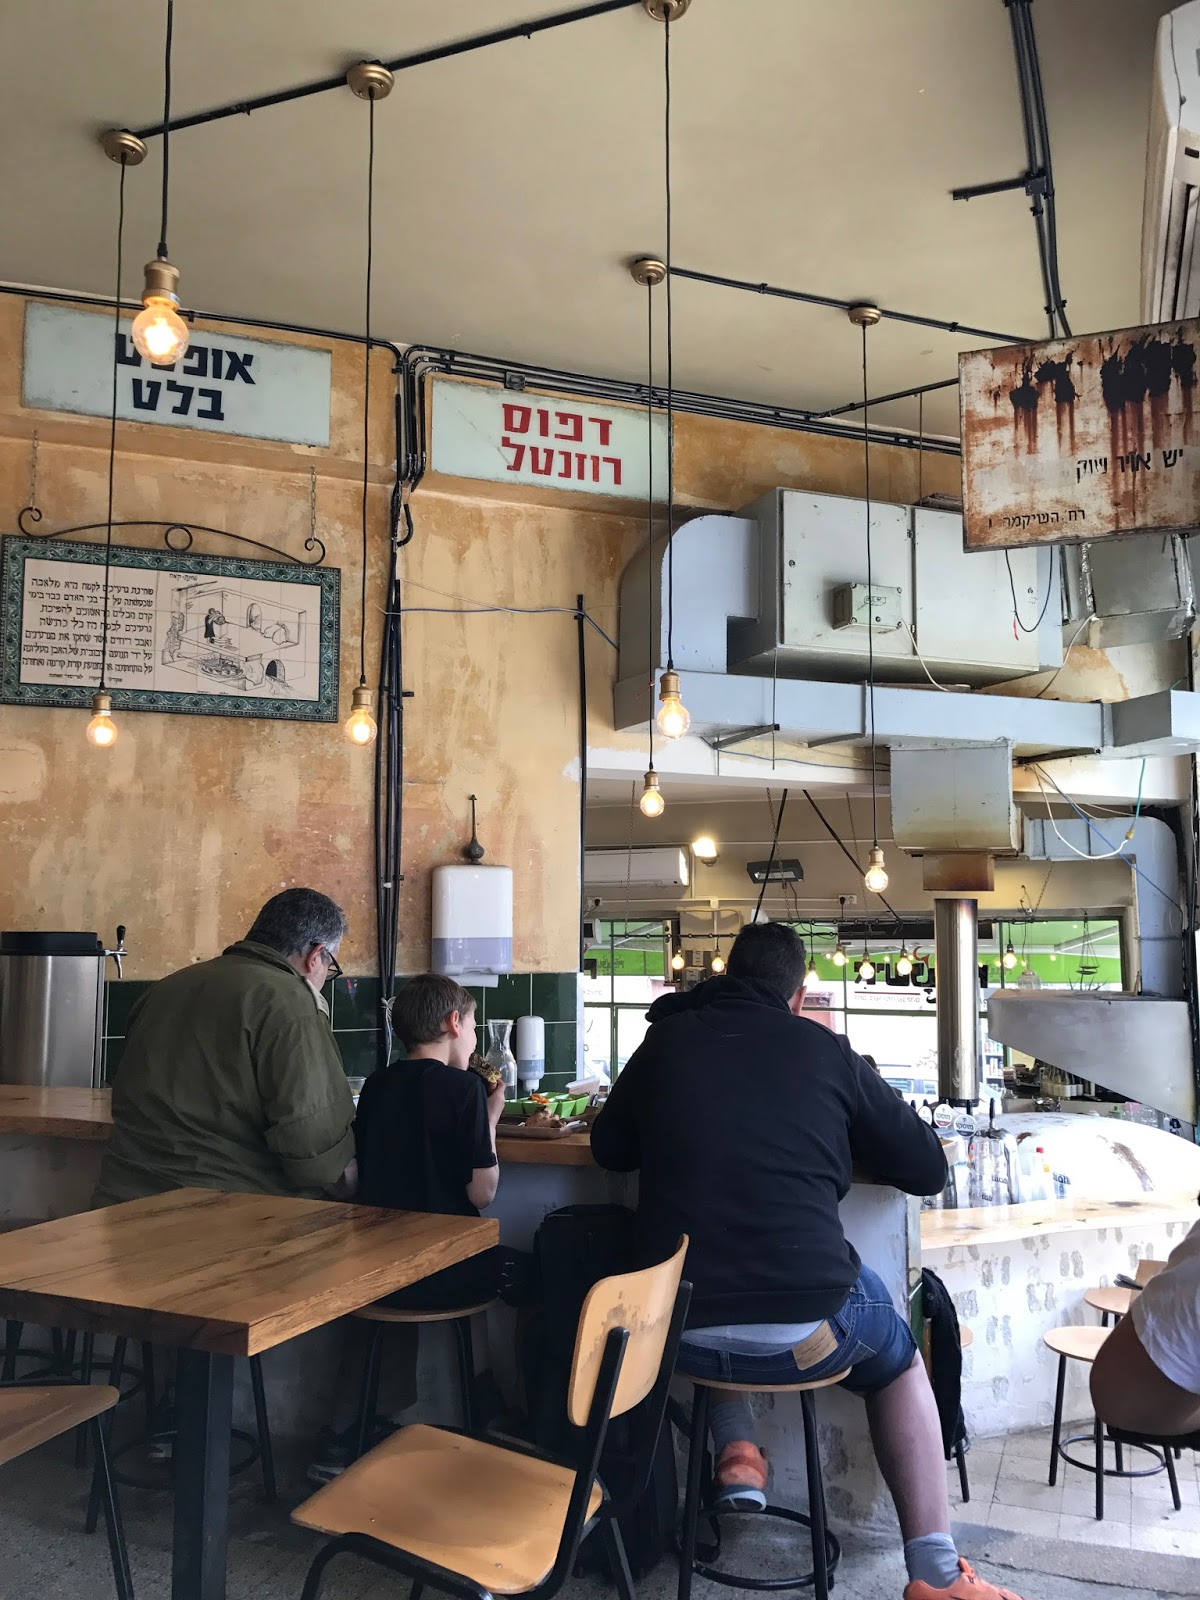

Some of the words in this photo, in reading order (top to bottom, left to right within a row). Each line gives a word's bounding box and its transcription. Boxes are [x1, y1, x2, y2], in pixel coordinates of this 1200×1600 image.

[115, 333, 256, 385] אופט
[132, 378, 225, 421] בלט
[501, 403, 613, 446] דפוס
[501, 436, 622, 485] רוזנטל
[1162, 448, 1184, 469] יש
[32, 578, 60, 587] מלאכה
[47, 592, 60, 600] כבר
[112, 596, 122, 605] על
[40, 605, 72, 616] להפיכת
[39, 617, 67, 627] כתישה
[139, 612, 153, 623] קדם
[59, 632, 69, 641] את
[80, 649, 106, 657] יבובית
[143, 650, 152, 660] על
